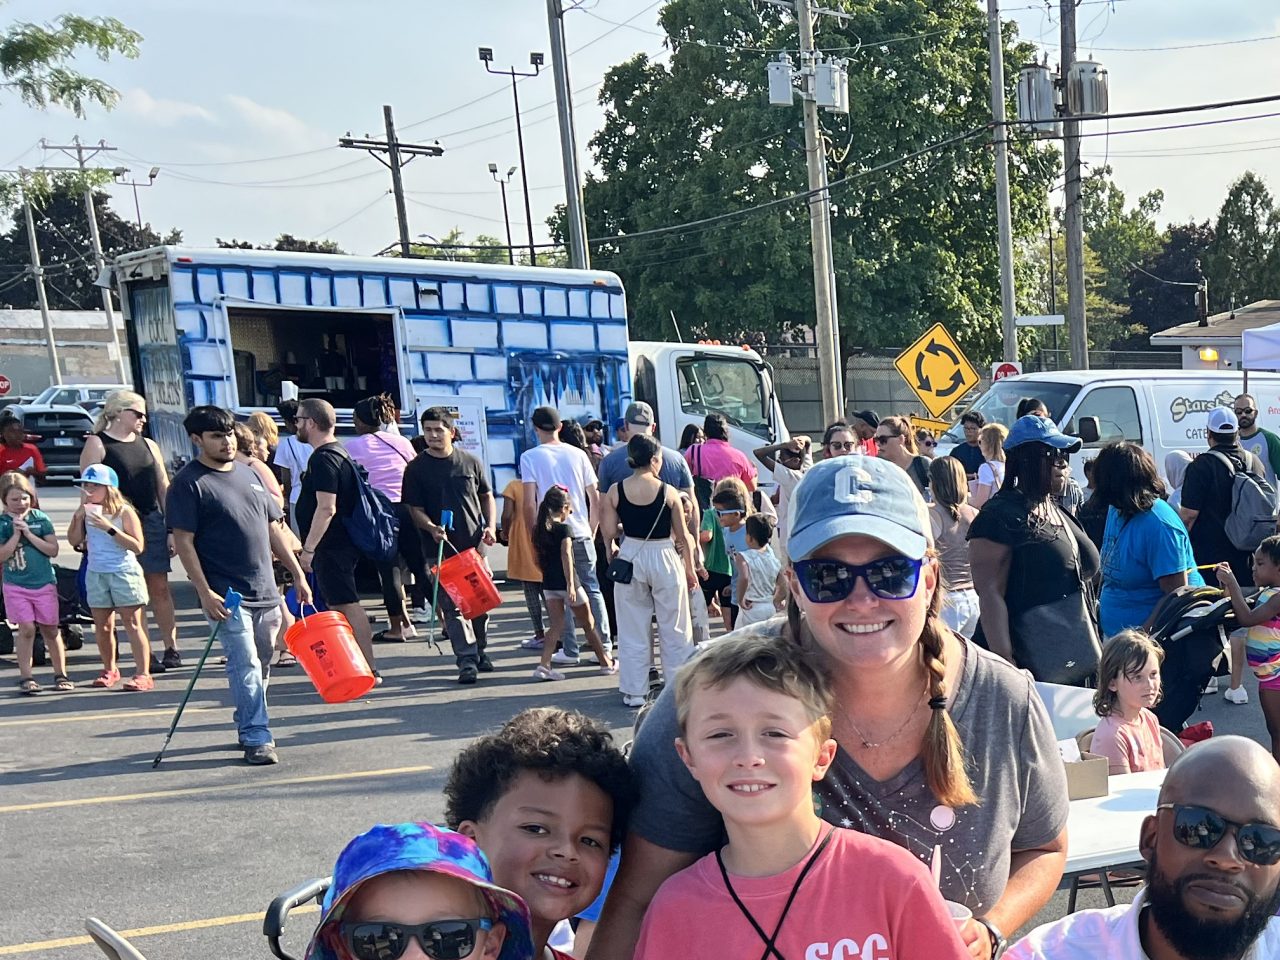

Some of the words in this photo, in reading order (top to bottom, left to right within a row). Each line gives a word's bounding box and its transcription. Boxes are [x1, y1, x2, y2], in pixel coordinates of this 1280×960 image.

[0, 380, 10, 389] OP
[1170, 396, 1222, 423] Stars
[1185, 428, 1208, 440] CATE
[834, 466, 874, 504] C
